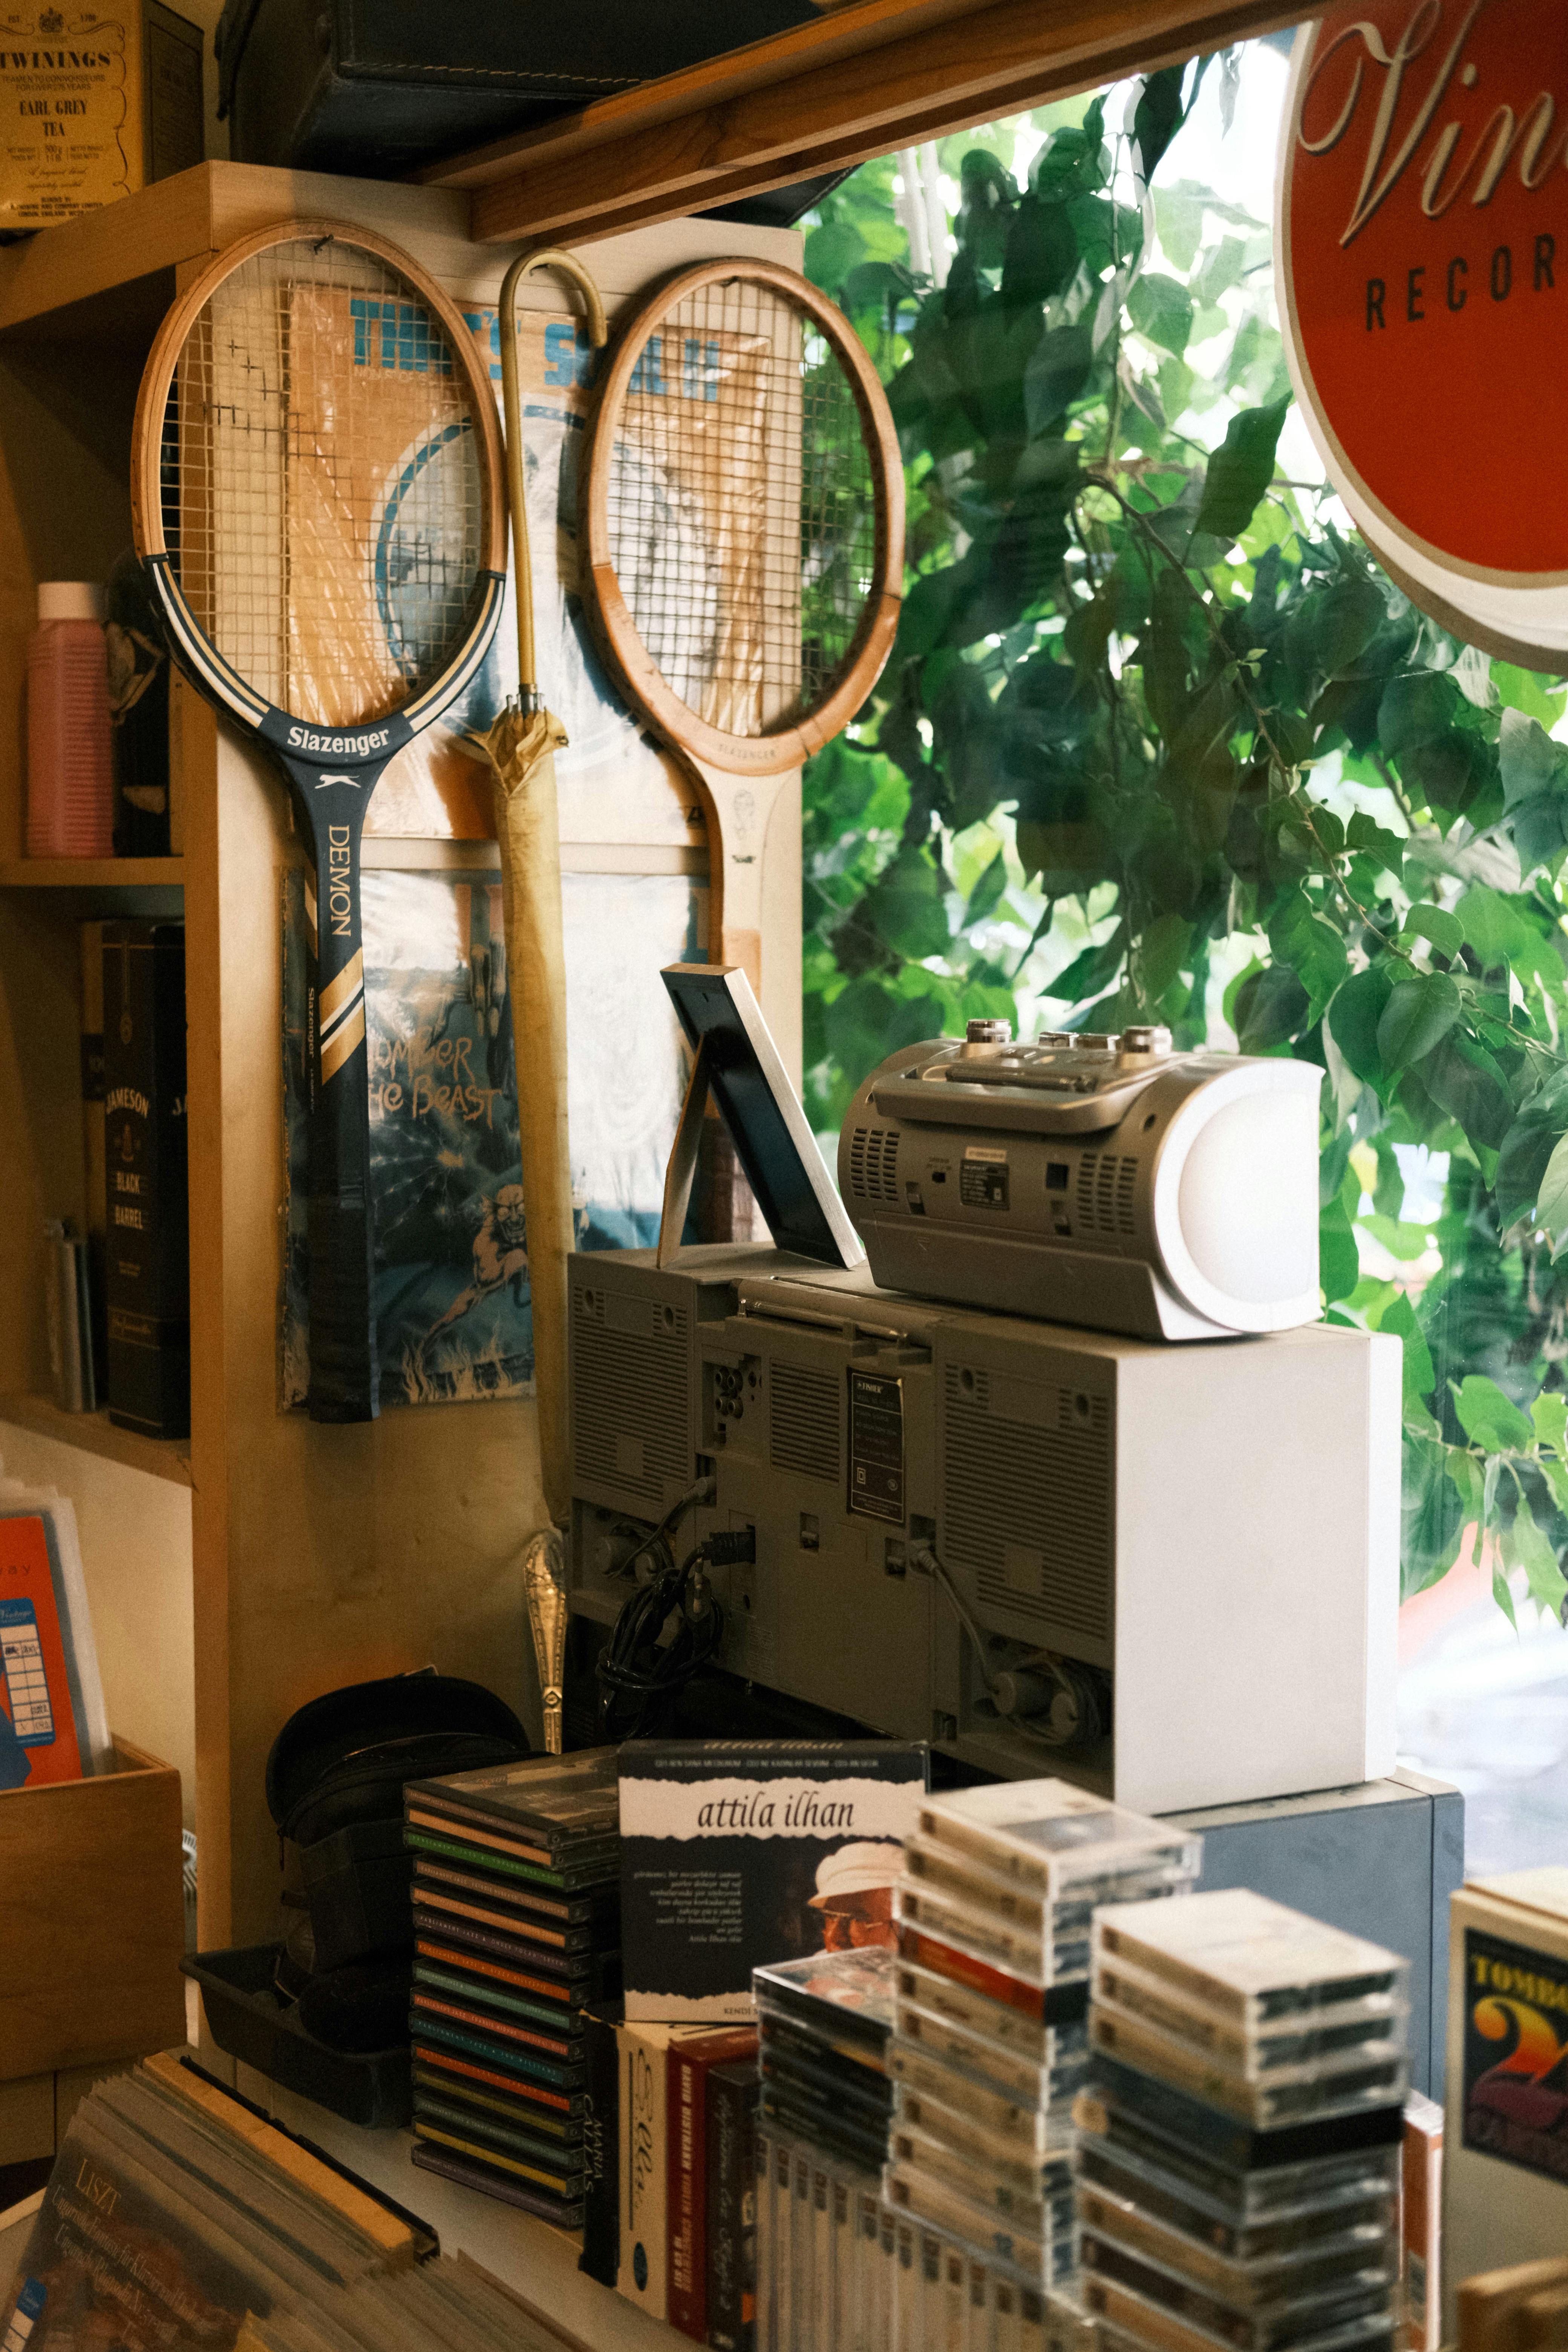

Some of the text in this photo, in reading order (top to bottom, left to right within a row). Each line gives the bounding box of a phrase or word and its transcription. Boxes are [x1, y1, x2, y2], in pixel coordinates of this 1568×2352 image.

[20, 99, 87, 115] EARL GREY
[43, 121, 65, 137] TEA
[1298, 0, 1568, 249] Vin
[1366, 233, 1556, 332] RECOR
[287, 726, 390, 756] Slazenger
[329, 825, 351, 937] DEMON
[106, 1087, 149, 1119] JAMESON
[116, 1170, 141, 1194] BLACK
[115, 1204, 144, 1230] BARREL
[698, 1790, 854, 1828] attila ilhan
[420, 1915, 459, 1932] PARLIAMENT
[462, 1929, 479, 1939] JAZZ
[419, 1945, 458, 1961] PARLIAMENT
[416, 1997, 451, 2012] PARLIAMENT
[452, 2009, 466, 2018] JAZZ
[418, 2021, 464, 2041] PARLIAMENT
[469, 2039, 487, 2050] JAZZ
[681, 2064, 692, 2104] DAVID
[583, 2094, 594, 2194] CALLAS
[593, 2118, 603, 2179] MARIA
[75, 2158, 122, 2216] LISZT
